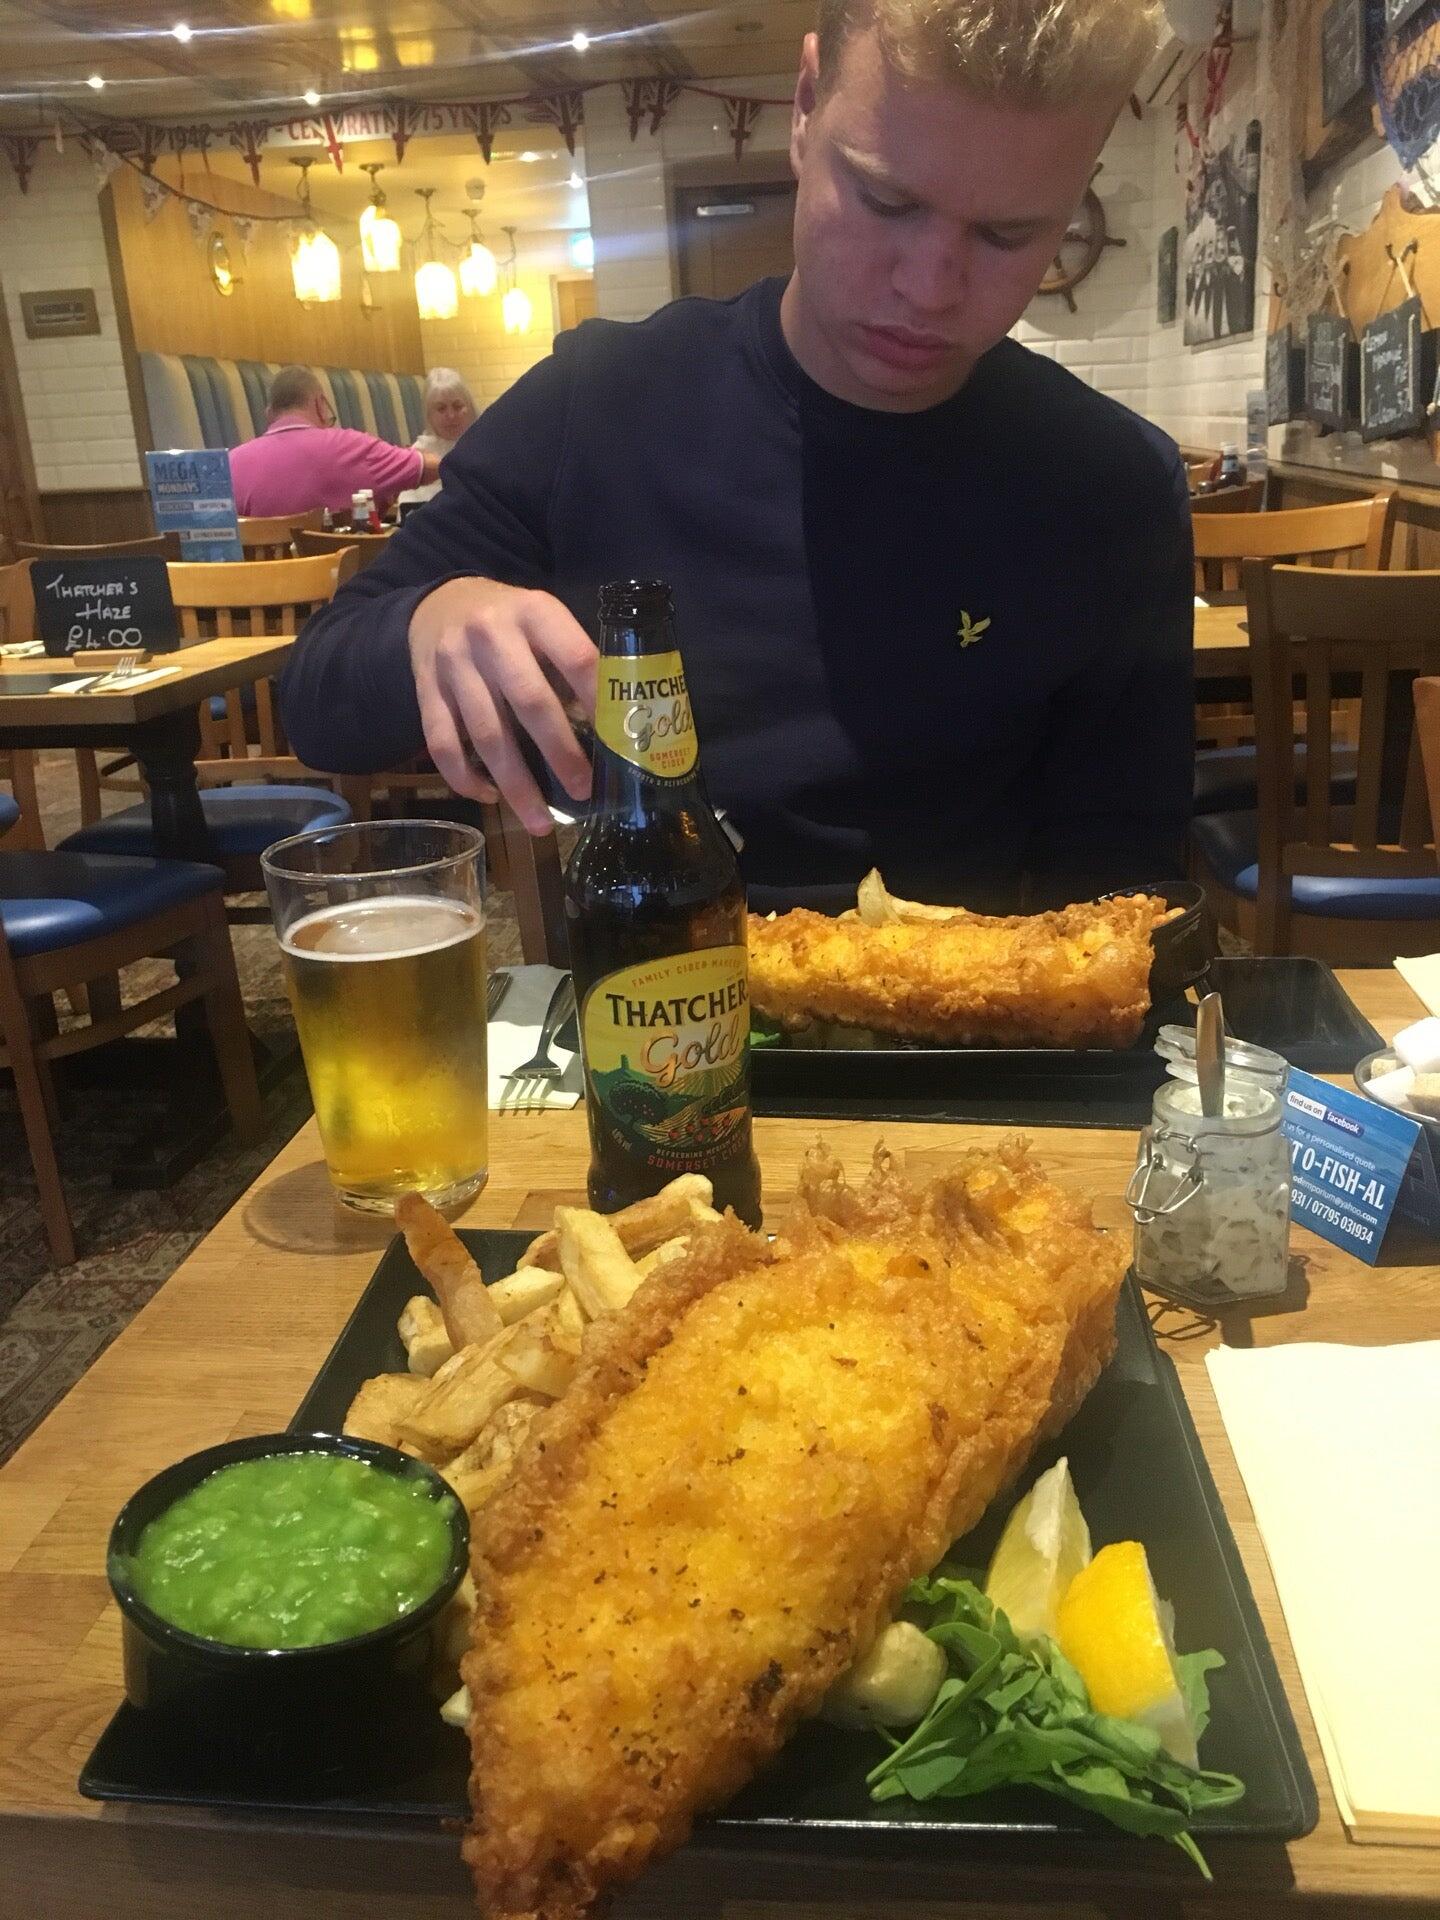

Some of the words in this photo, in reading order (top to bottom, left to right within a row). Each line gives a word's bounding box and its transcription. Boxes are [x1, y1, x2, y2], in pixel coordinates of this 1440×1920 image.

[153, 461, 198, 480] MEGA
[46, 573, 139, 600] THATCHER'S
[75, 599, 132, 621] HAZE
[608, 675, 688, 700] THATCHE
[624, 697, 693, 752] Gold
[631, 969, 671, 988] FAMILY
[606, 980, 748, 1028] THATCHER
[641, 1015, 742, 1087] Gold
[1289, 1094, 1304, 1106] find
[1303, 1101, 1313, 1111] us
[1313, 1107, 1323, 1116] on
[1327, 1112, 1360, 1134] facebook
[647, 1154, 719, 1171] SOMERSET
[1310, 1135, 1355, 1160] personalised
[1354, 1156, 1376, 1171] quote
[1302, 1147, 1386, 1210] O-FISH-AL
[1291, 1189, 1306, 1207] 931
[1311, 1200, 1341, 1226] 07795
[1340, 1216, 1375, 1244] 031934
[1293, 1175, 1378, 1225] odemporium@yahoo.com
